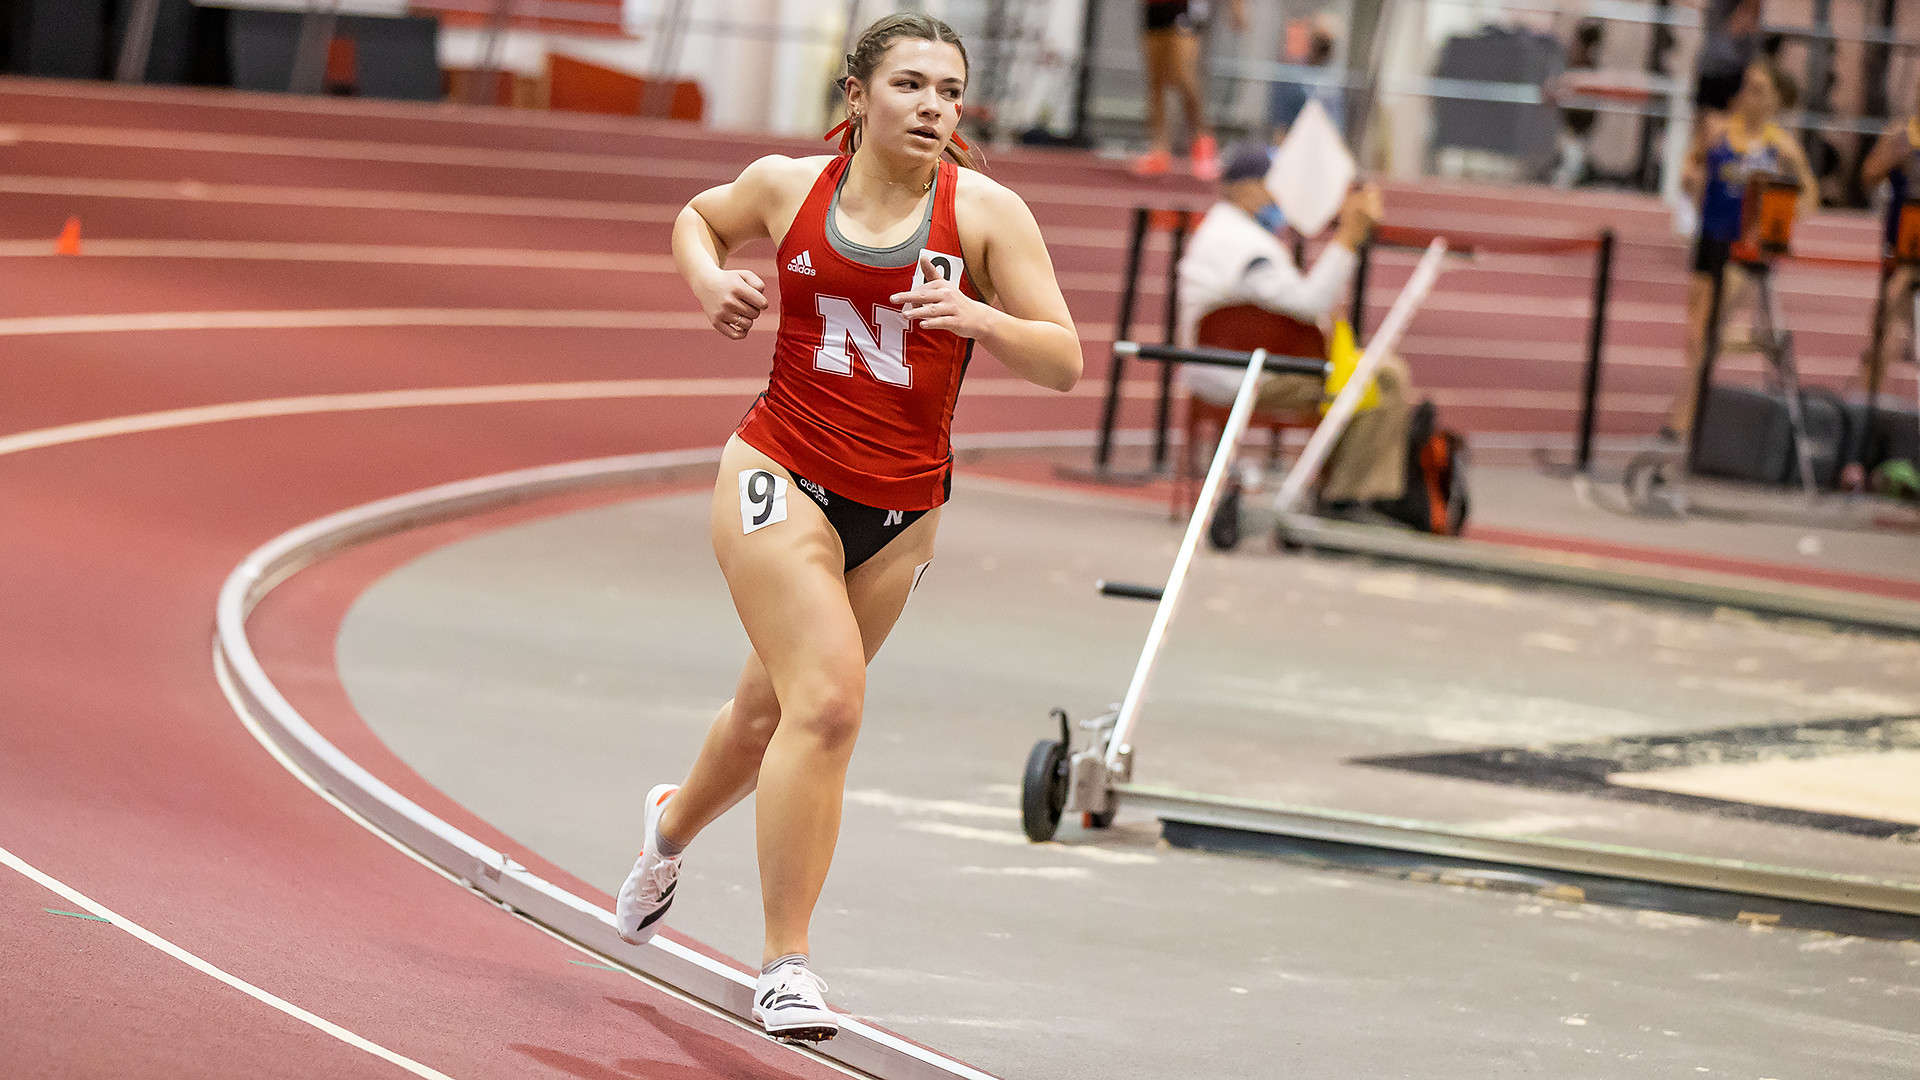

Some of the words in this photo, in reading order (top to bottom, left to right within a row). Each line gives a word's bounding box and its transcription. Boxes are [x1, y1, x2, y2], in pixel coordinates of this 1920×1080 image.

[787, 262, 816, 277] adidas
[814, 293, 913, 389] N
[748, 470, 776, 525] 9
[800, 478, 829, 506] addas
[884, 510, 904, 526] N
